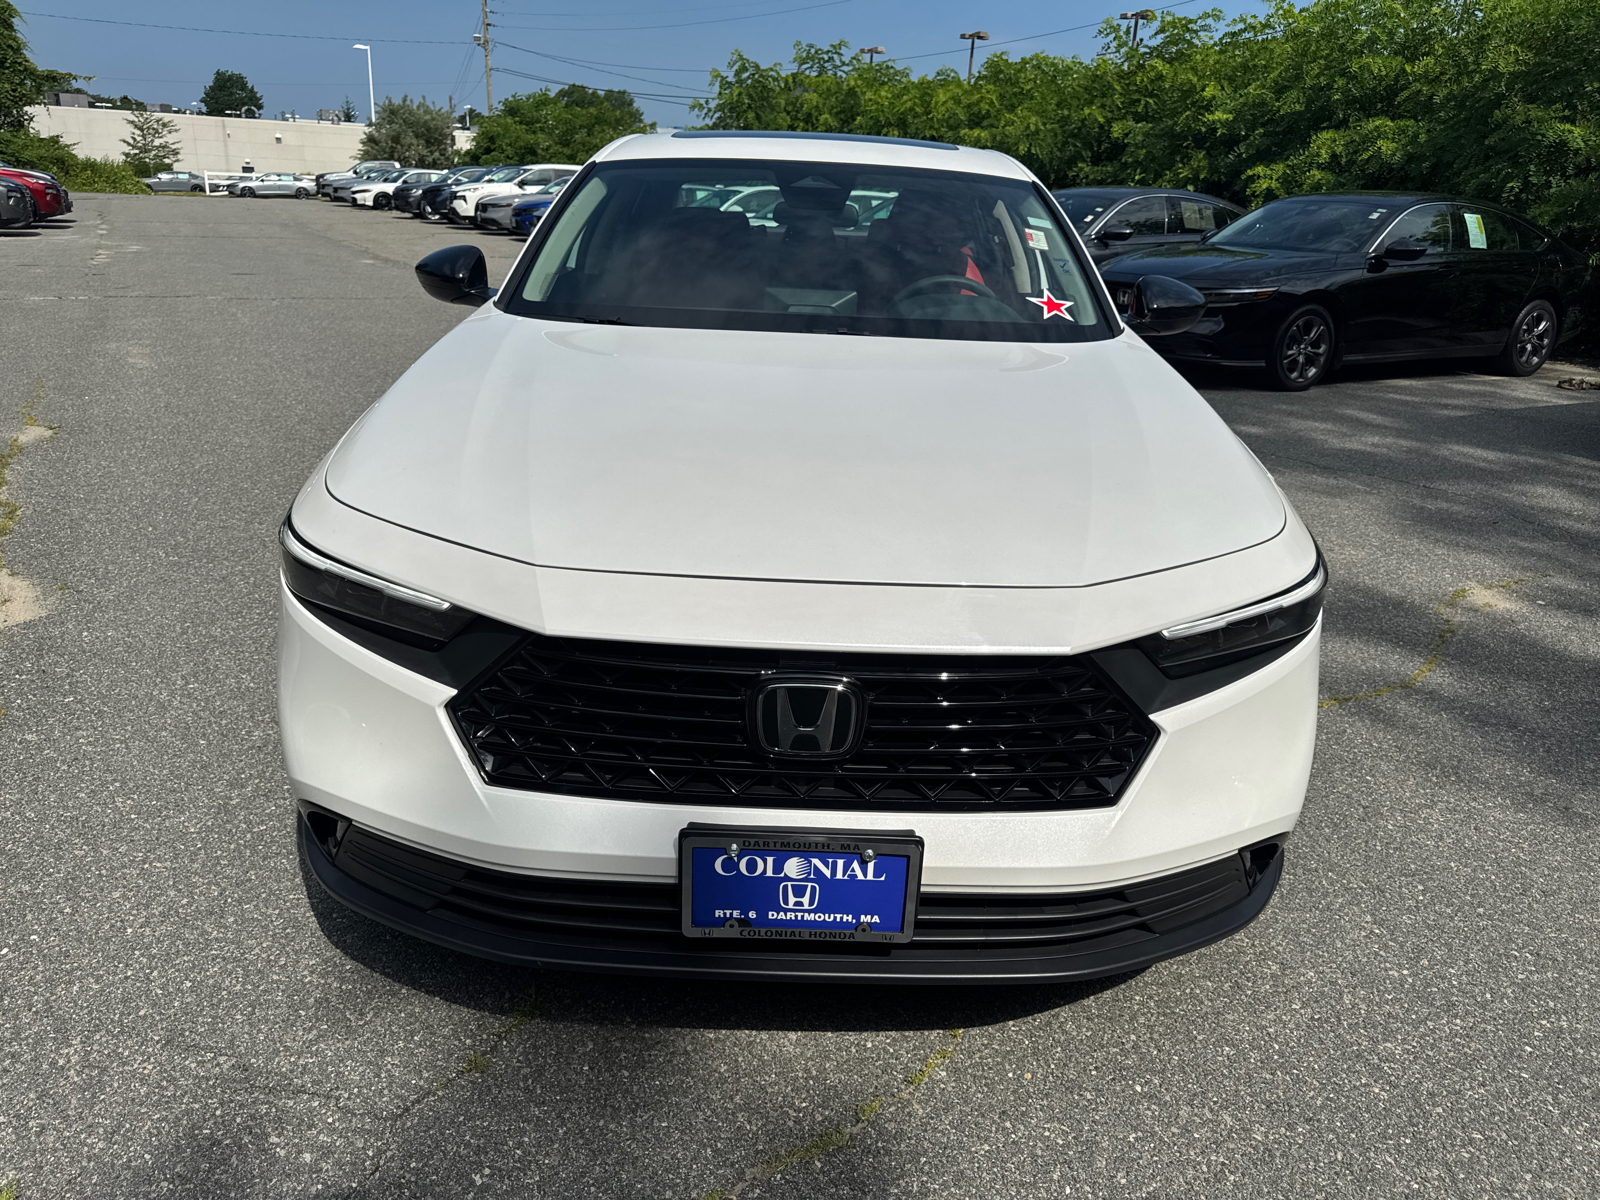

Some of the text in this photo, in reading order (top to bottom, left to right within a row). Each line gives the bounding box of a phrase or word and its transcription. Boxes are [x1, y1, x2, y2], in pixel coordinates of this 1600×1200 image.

[839, 843, 861, 851] MA
[714, 855, 886, 881] COLONIAL
[715, 909, 881, 924] RTE. 6 DARTMOUTH, MA
[739, 929, 856, 940] COLONIAL HONDA
